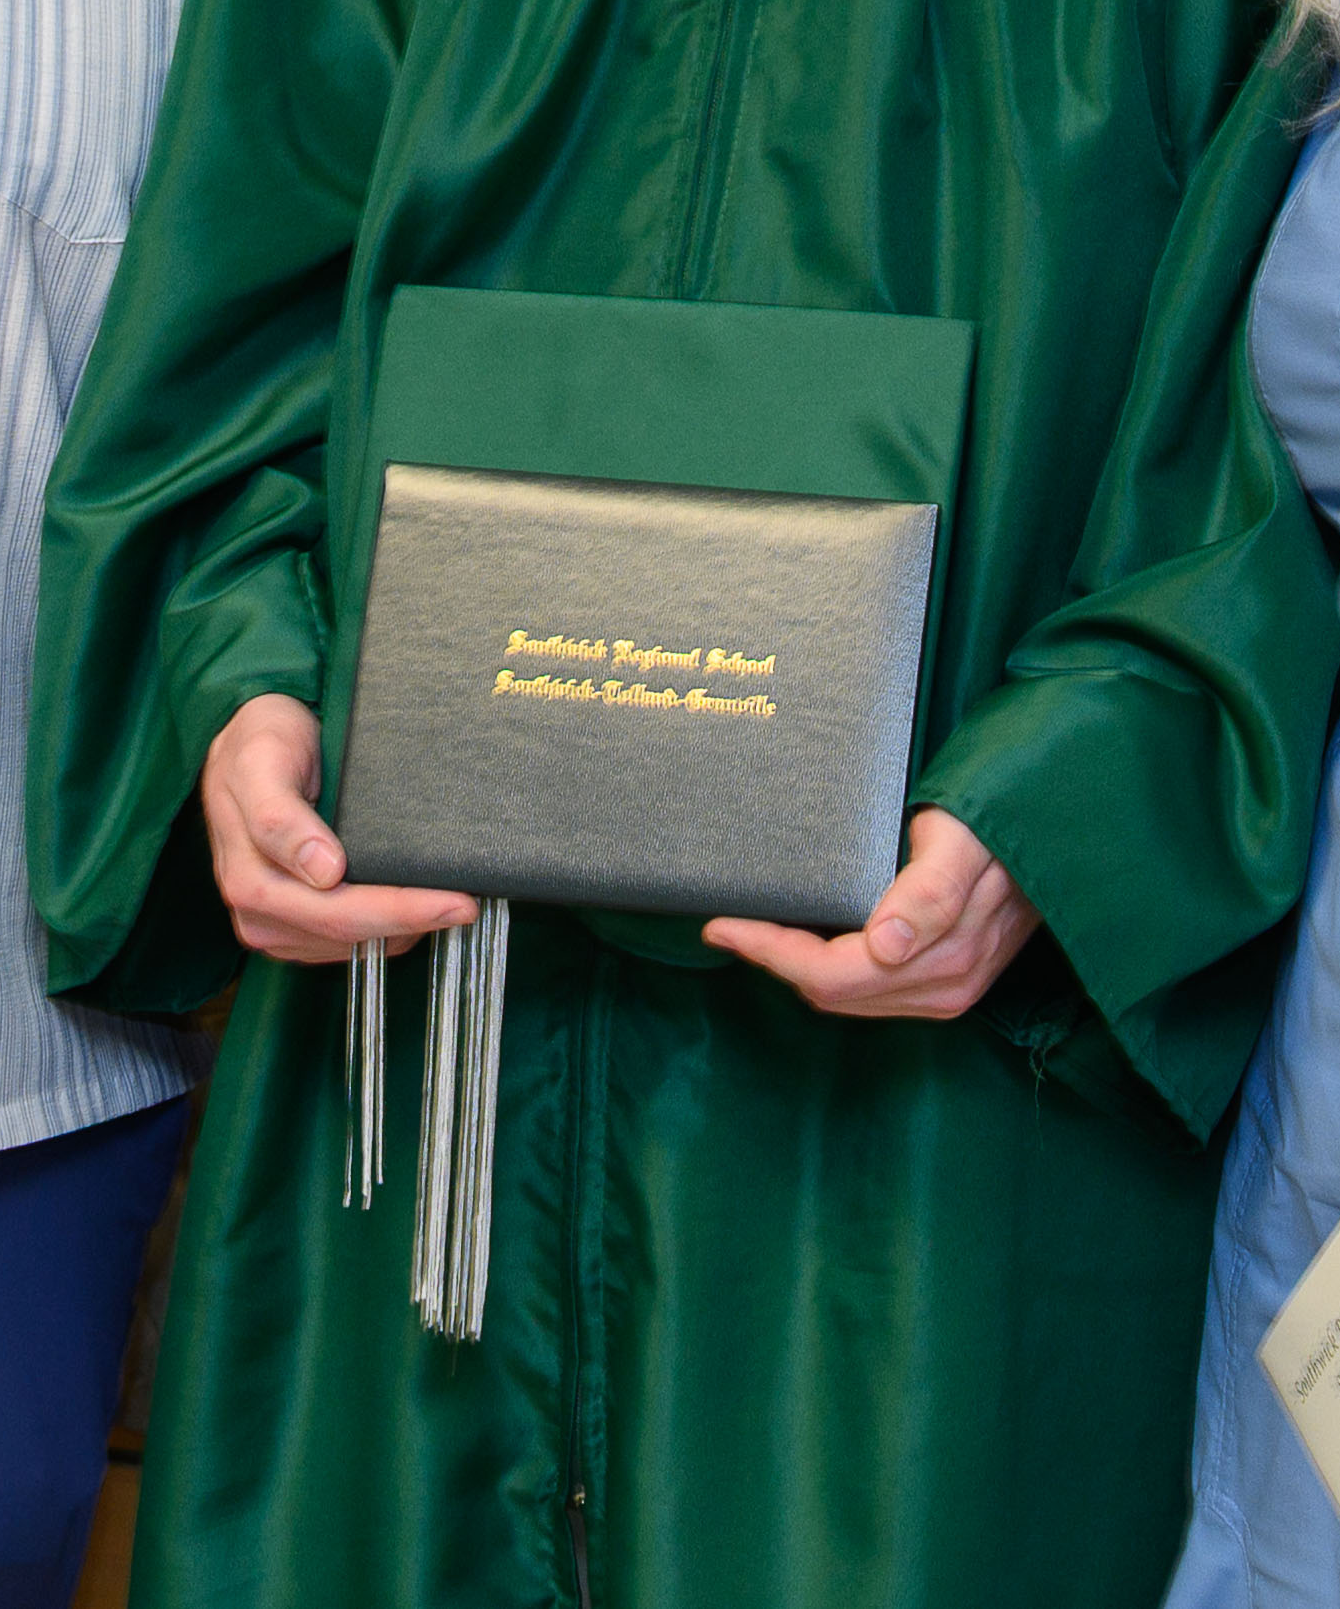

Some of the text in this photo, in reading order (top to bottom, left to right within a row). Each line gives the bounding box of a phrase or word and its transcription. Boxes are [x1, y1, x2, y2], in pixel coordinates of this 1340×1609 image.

[504, 630, 777, 676] Southwick Regional School
[1294, 1327, 1340, 1404] Southwick
